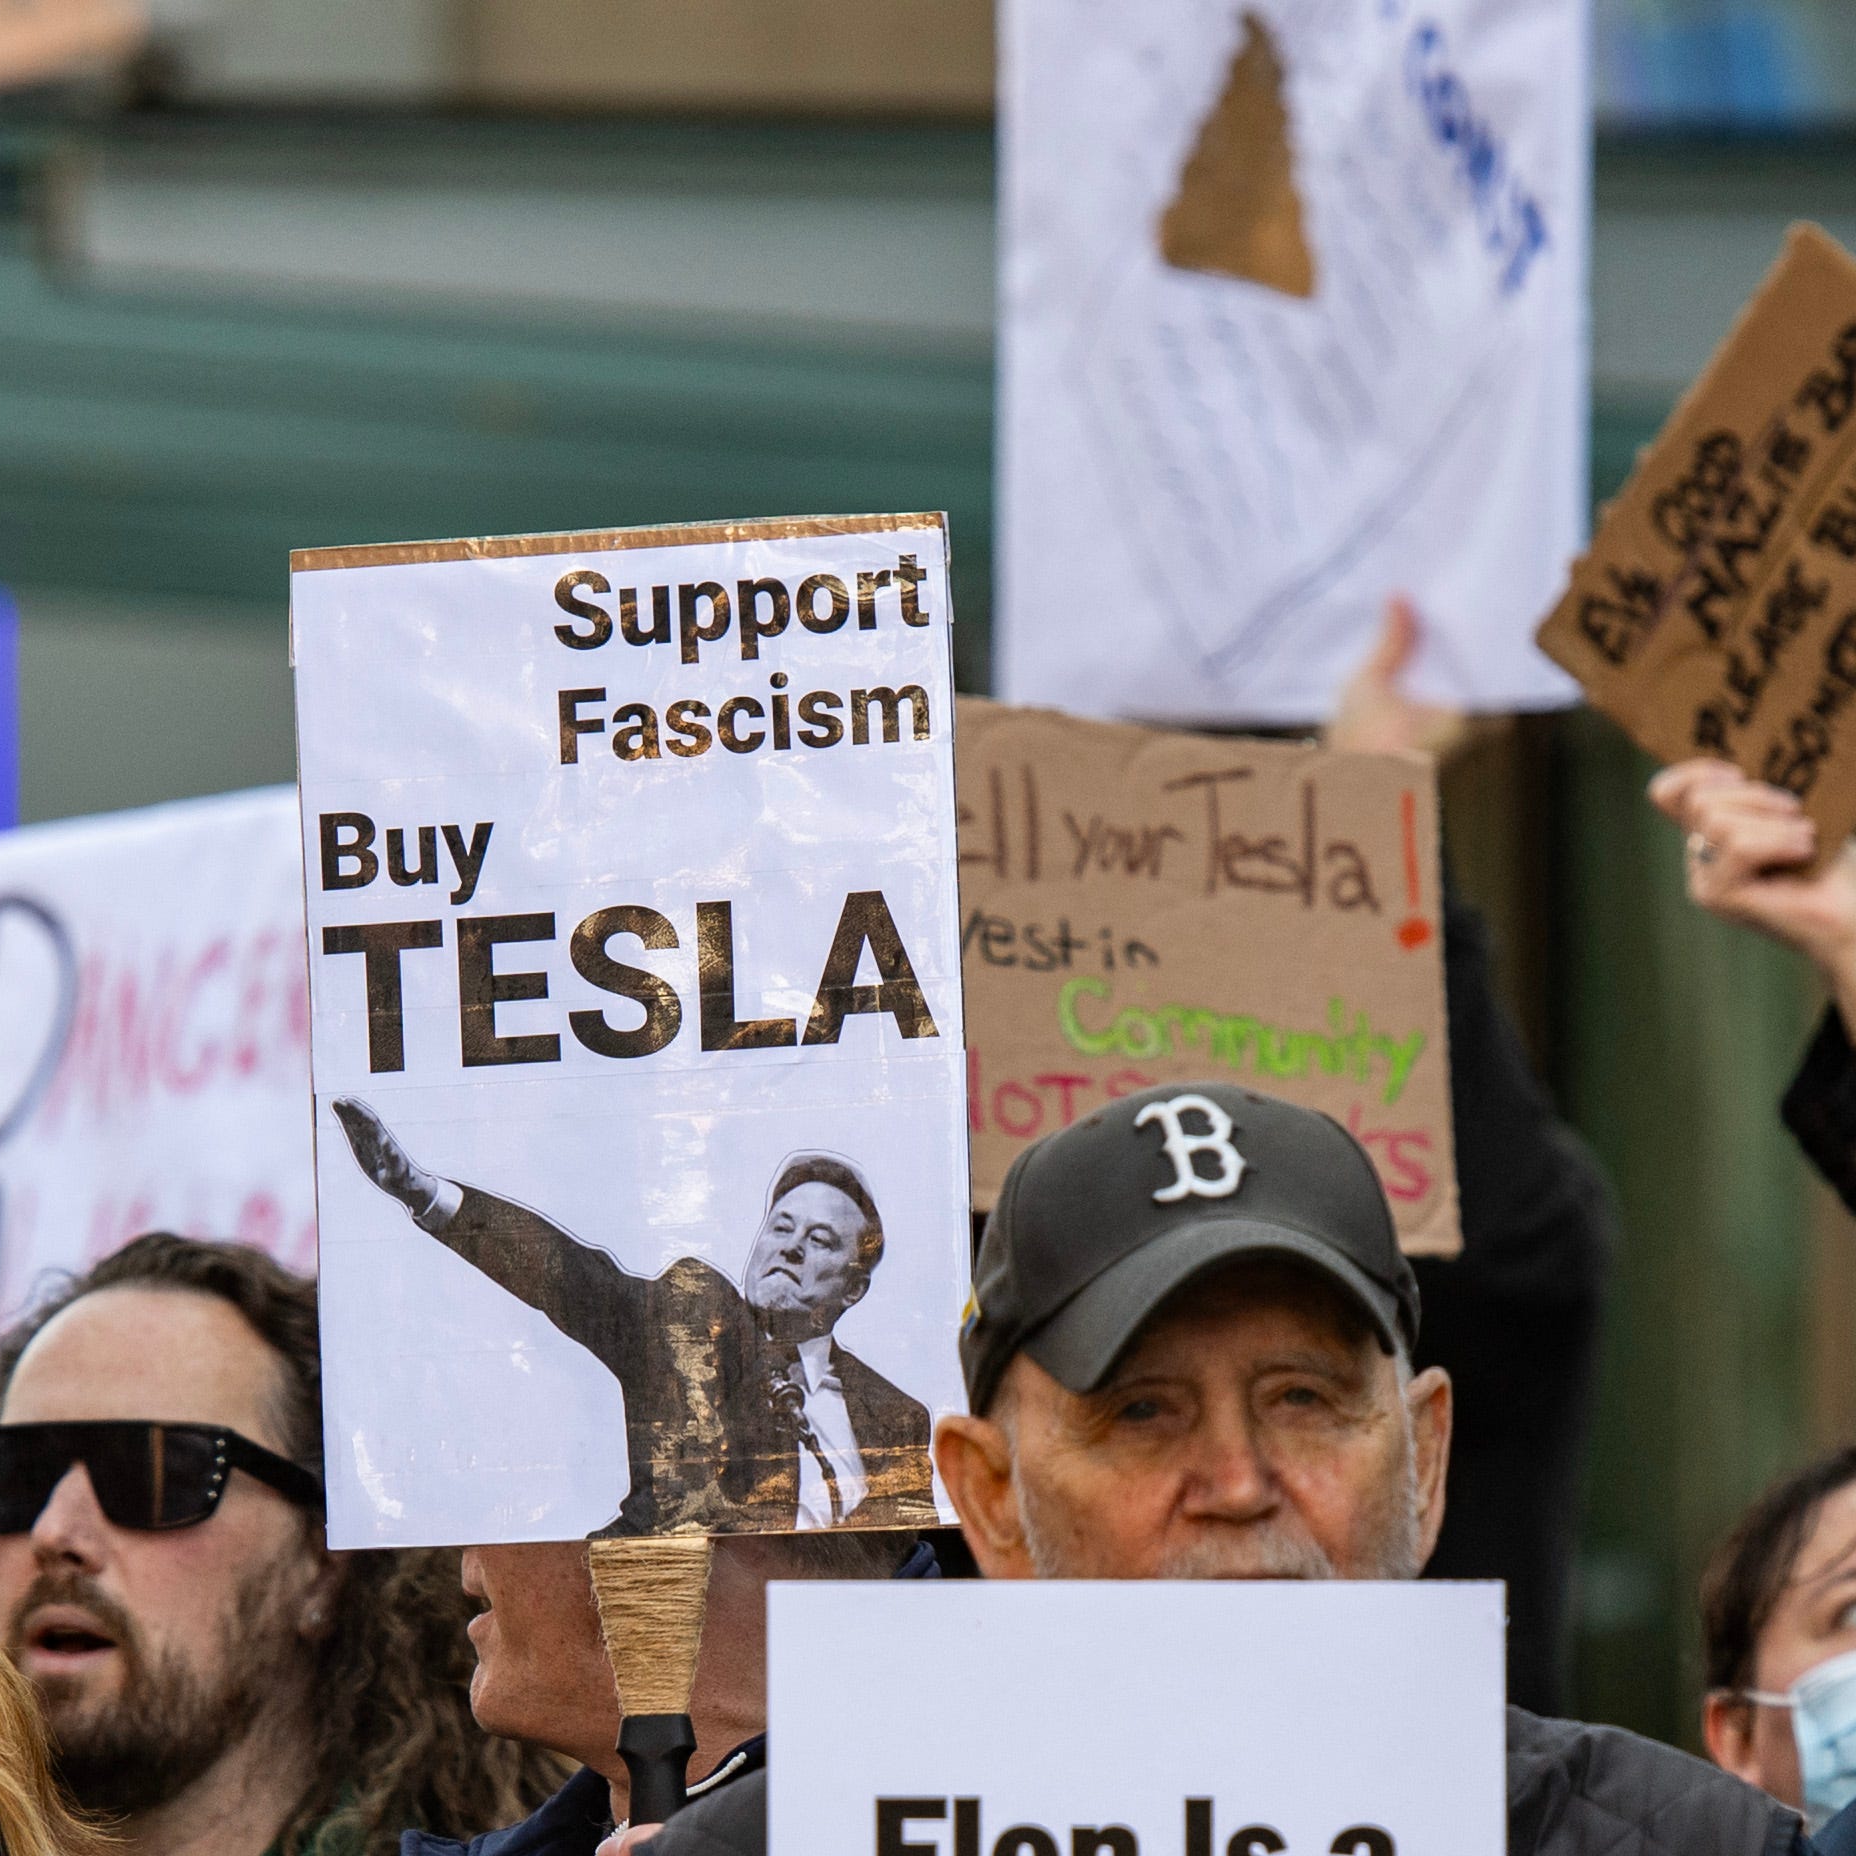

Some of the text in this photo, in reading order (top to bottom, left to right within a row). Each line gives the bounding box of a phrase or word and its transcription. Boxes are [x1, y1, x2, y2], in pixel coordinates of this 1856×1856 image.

[553, 553, 930, 664] Support
[1693, 558, 1830, 759] PLEASE
[556, 672, 931, 765] Fascism
[318, 811, 494, 905] Buy
[1062, 806, 1184, 882] your
[322, 890, 940, 1074] TESLA
[1057, 974, 1426, 1106] Community
[1134, 1093, 1247, 1203] B
